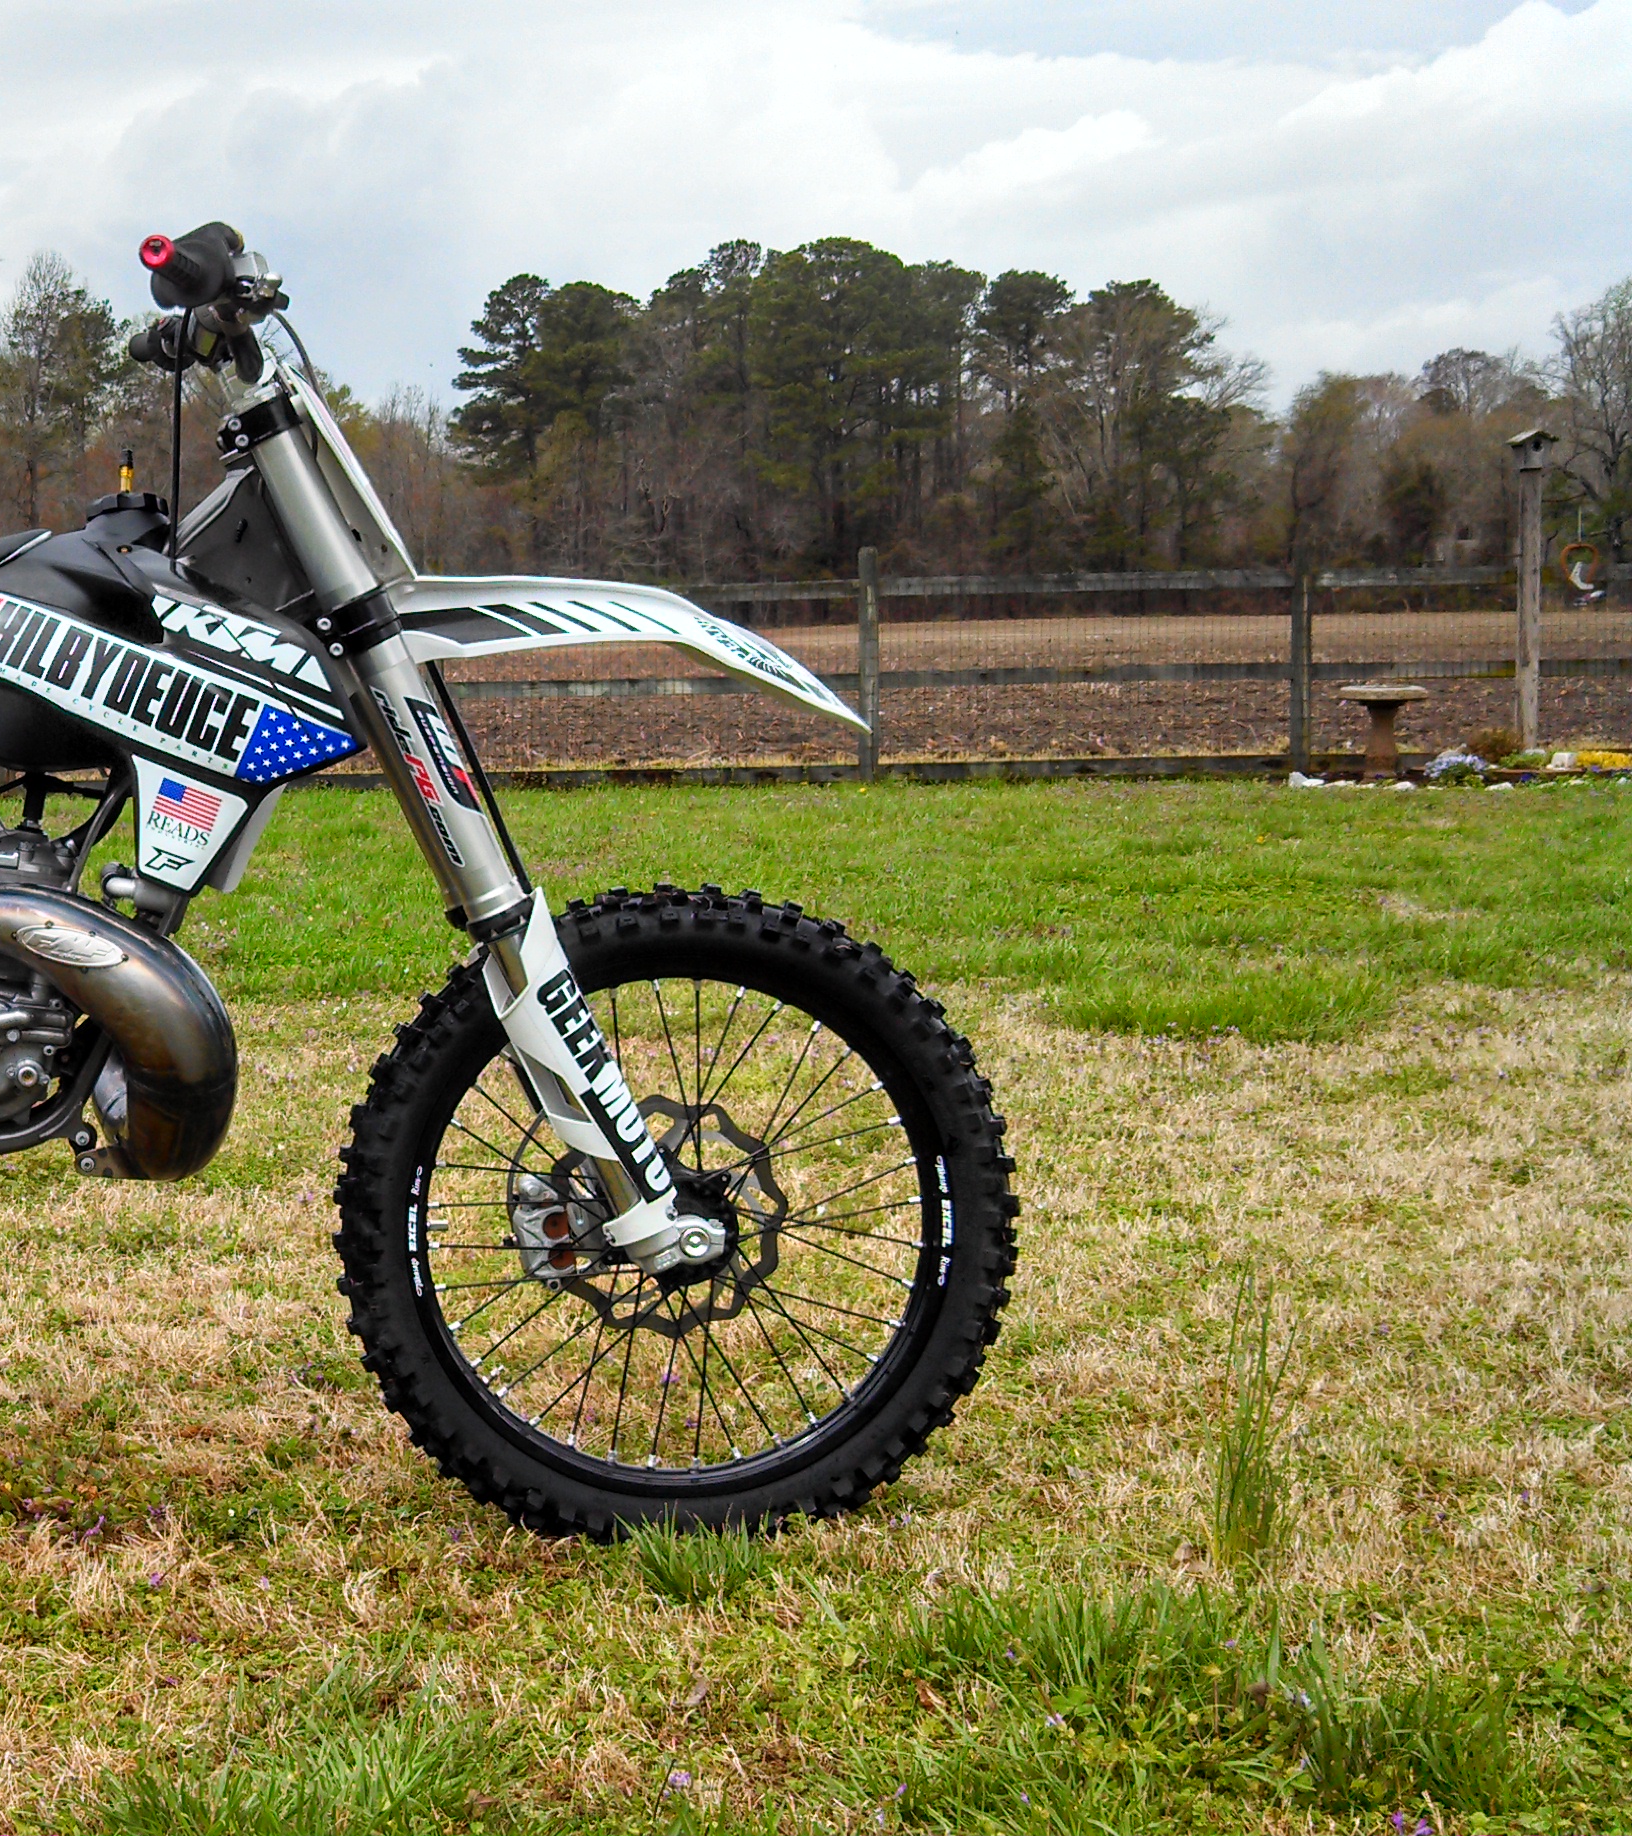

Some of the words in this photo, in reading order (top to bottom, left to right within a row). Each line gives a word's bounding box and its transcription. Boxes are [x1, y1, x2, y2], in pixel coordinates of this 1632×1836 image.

[159, 601, 310, 677] KTM
[159, 737, 229, 770] PARTS
[146, 810, 212, 847] READS
[536, 968, 613, 1085] GEEK
[591, 1060, 672, 1192] MOTO
[408, 1203, 418, 1252] EXCEL
[941, 1199, 952, 1248] EXCEL
